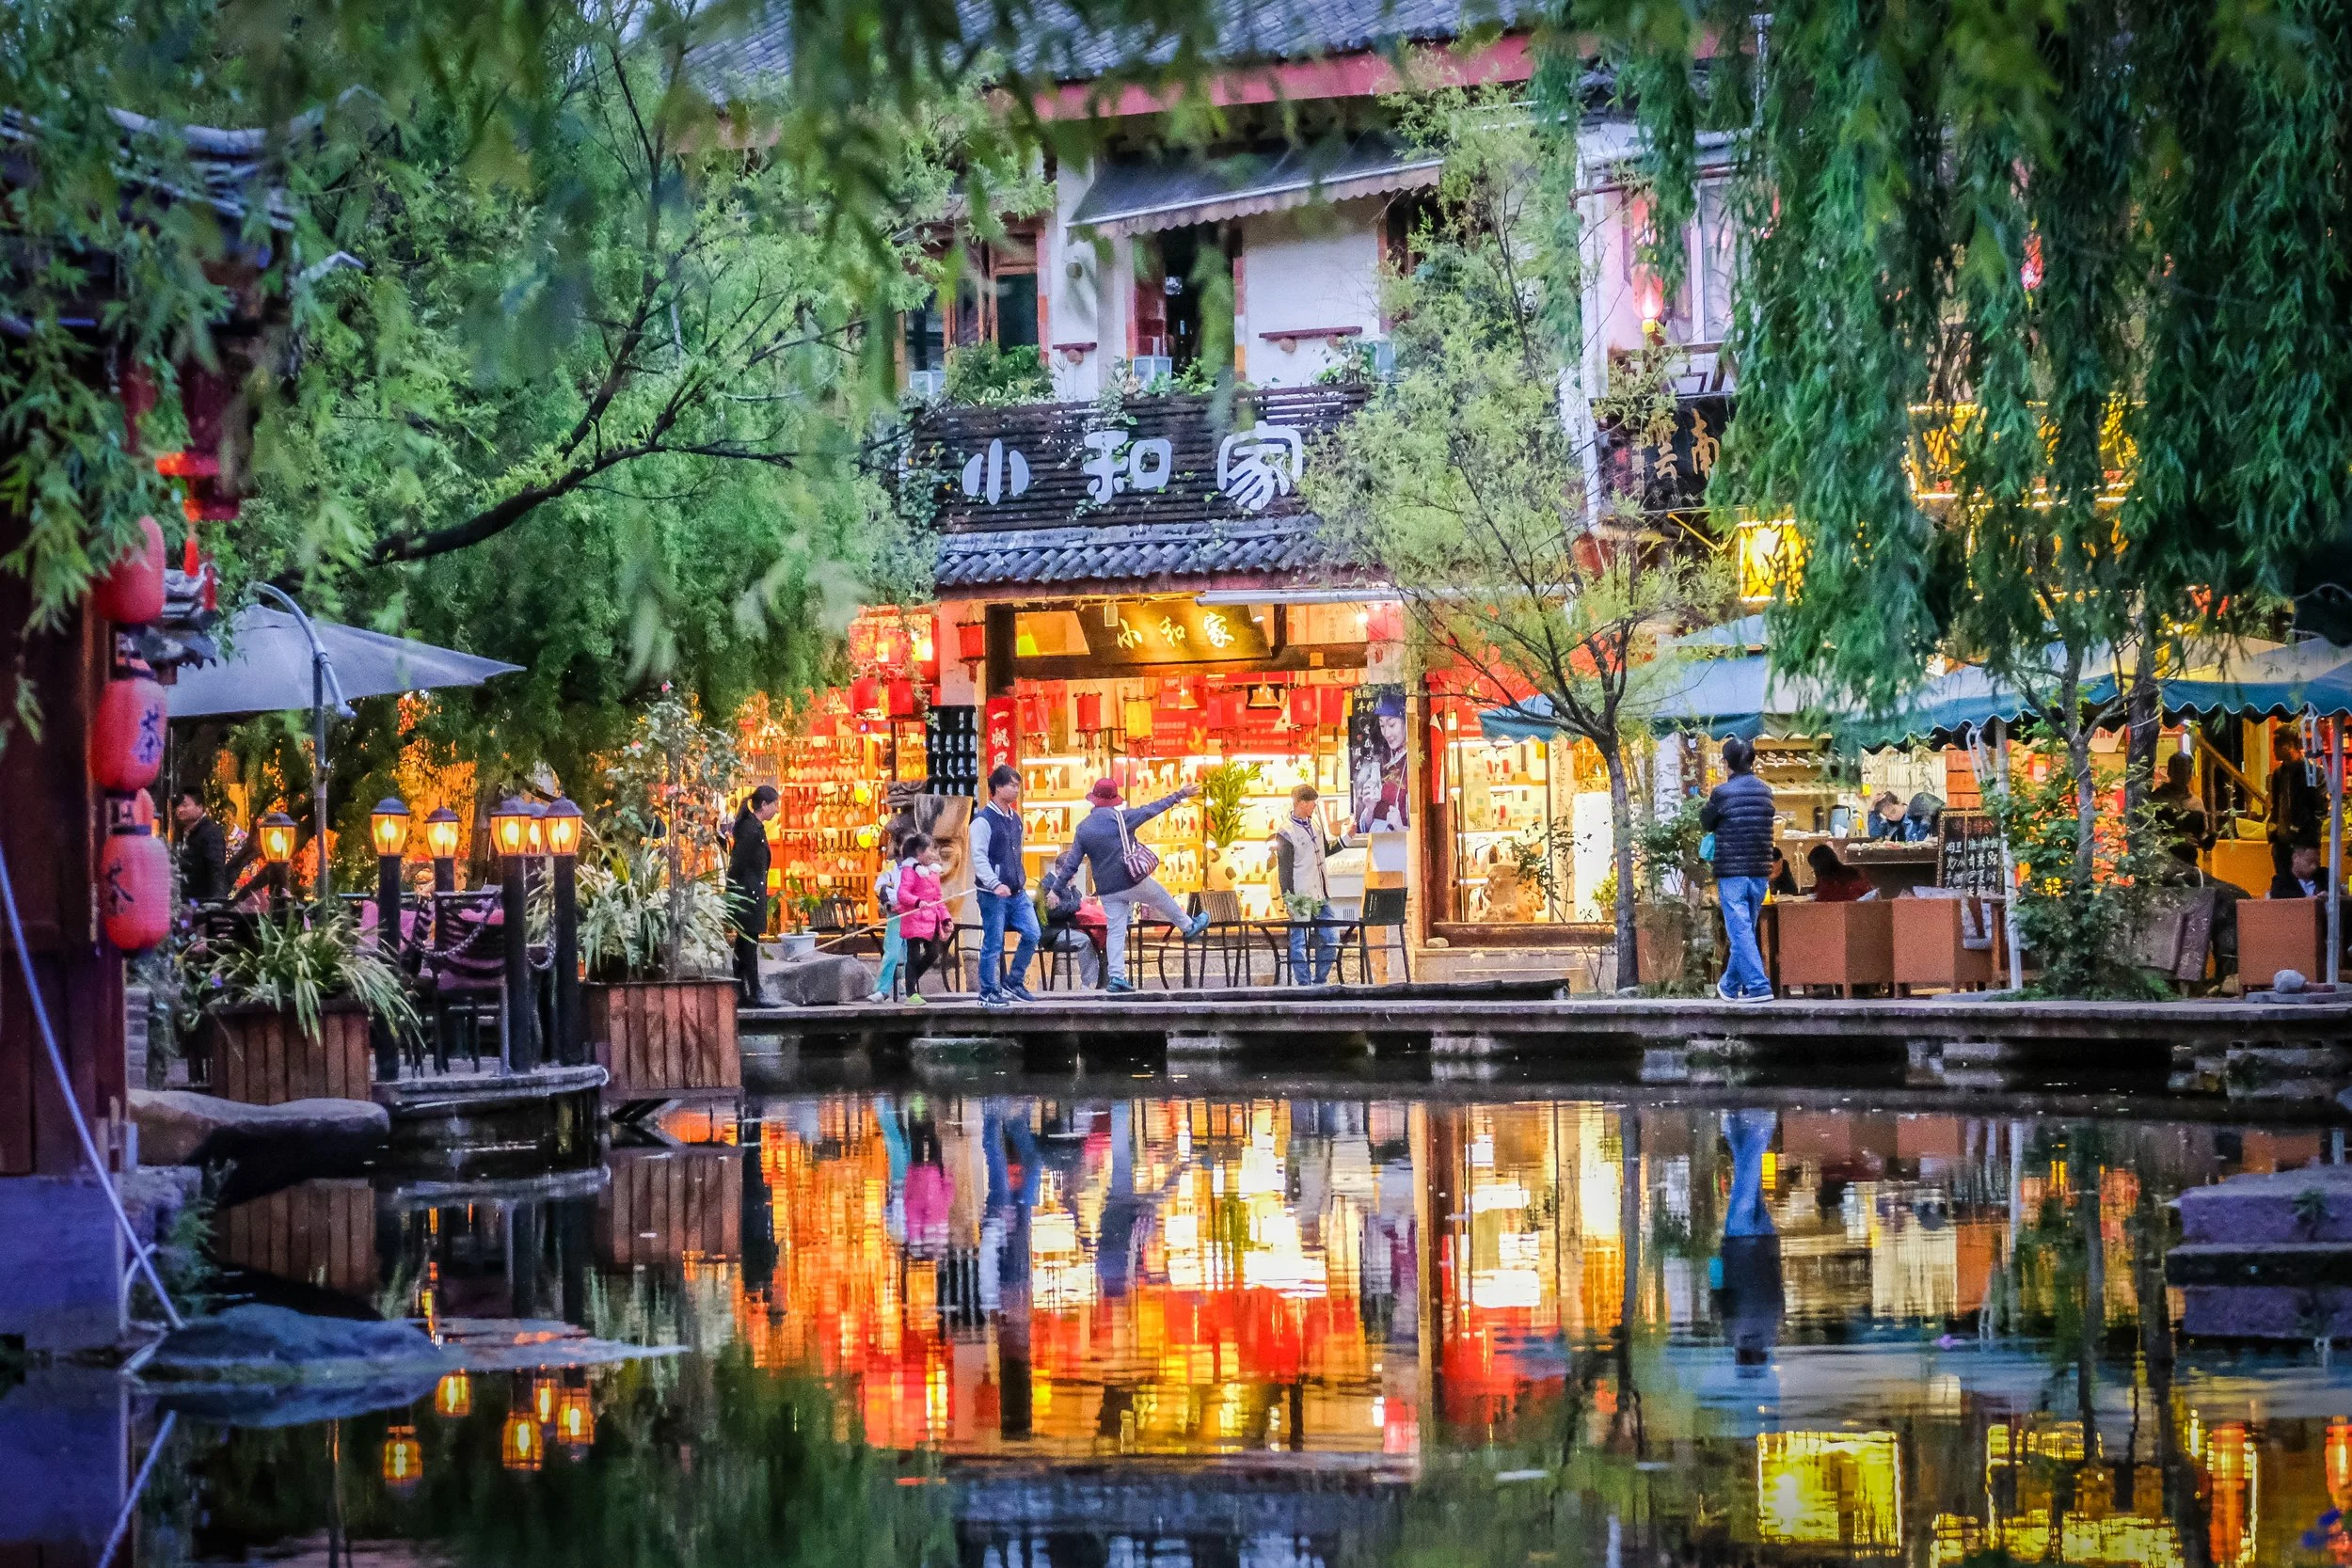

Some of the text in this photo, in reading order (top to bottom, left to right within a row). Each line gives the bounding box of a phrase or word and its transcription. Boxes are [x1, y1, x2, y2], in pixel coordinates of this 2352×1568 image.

[961, 420, 1303, 511] 小和家
[1117, 610, 1234, 648] 小和家
